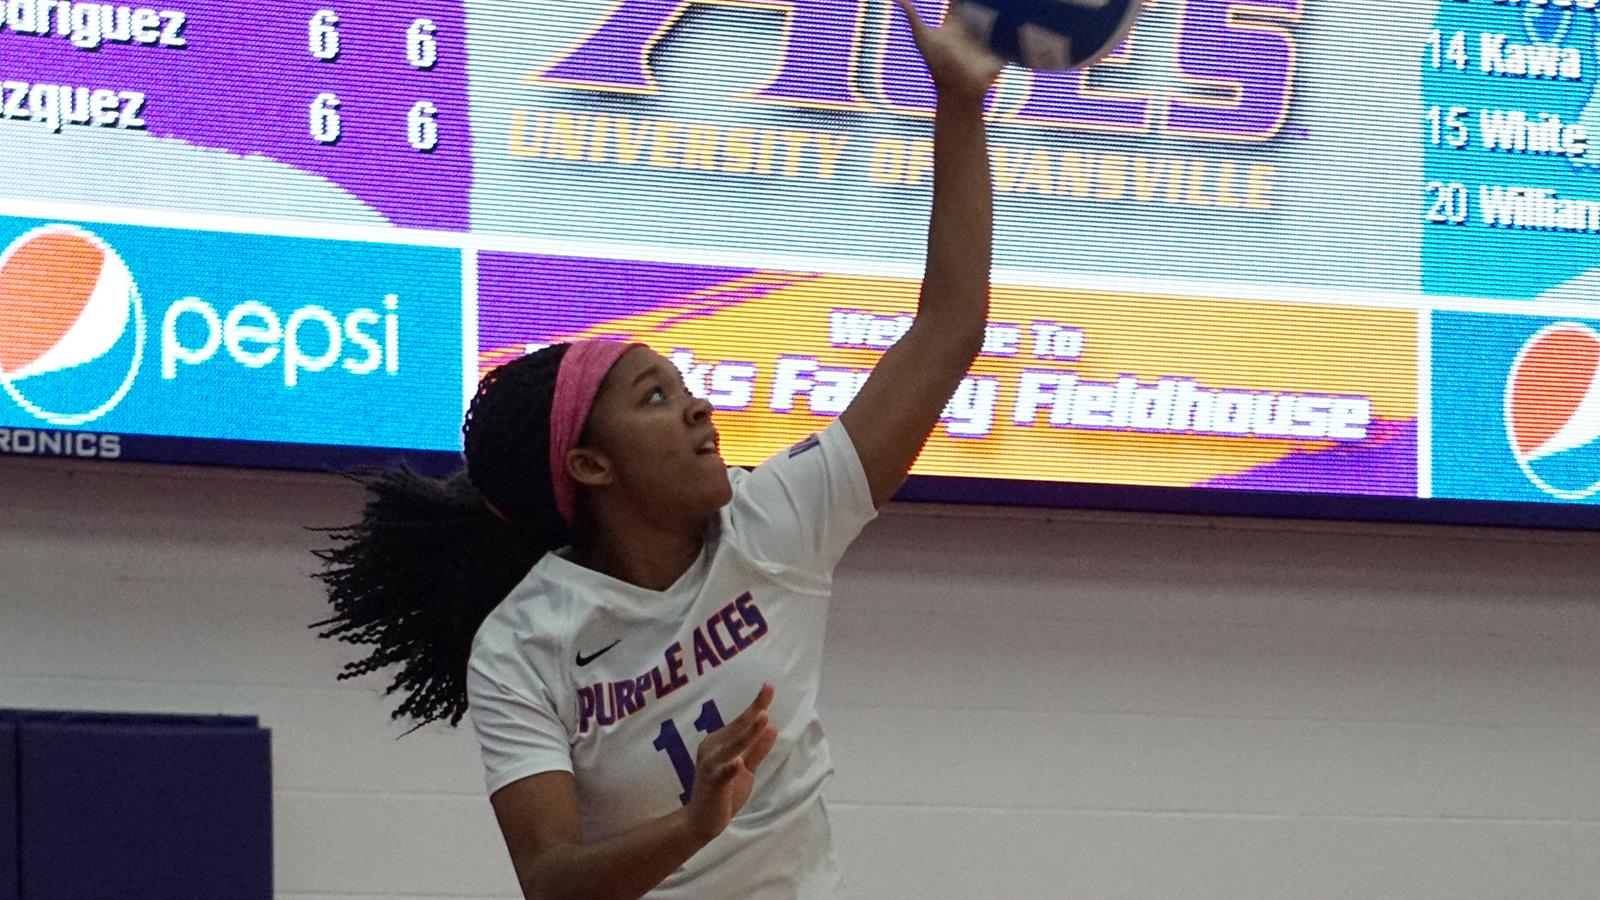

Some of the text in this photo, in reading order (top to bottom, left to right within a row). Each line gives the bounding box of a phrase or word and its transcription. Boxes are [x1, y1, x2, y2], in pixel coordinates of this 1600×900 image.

[0, 0, 437, 68] driguez 6 6
[1425, 29, 1582, 79] 14 Kawa
[0, 80, 438, 151] zquez 6 6
[1426, 105, 1588, 154] 15 White
[509, 109, 1276, 209] UNIVERSITY OF VANSVILLE
[1425, 181, 1469, 223] 20
[161, 293, 400, 388] pepsi
[1029, 321, 1084, 358] To
[1013, 370, 1372, 440] Fieldhouse
[576, 590, 769, 734] PURPLE ACES
